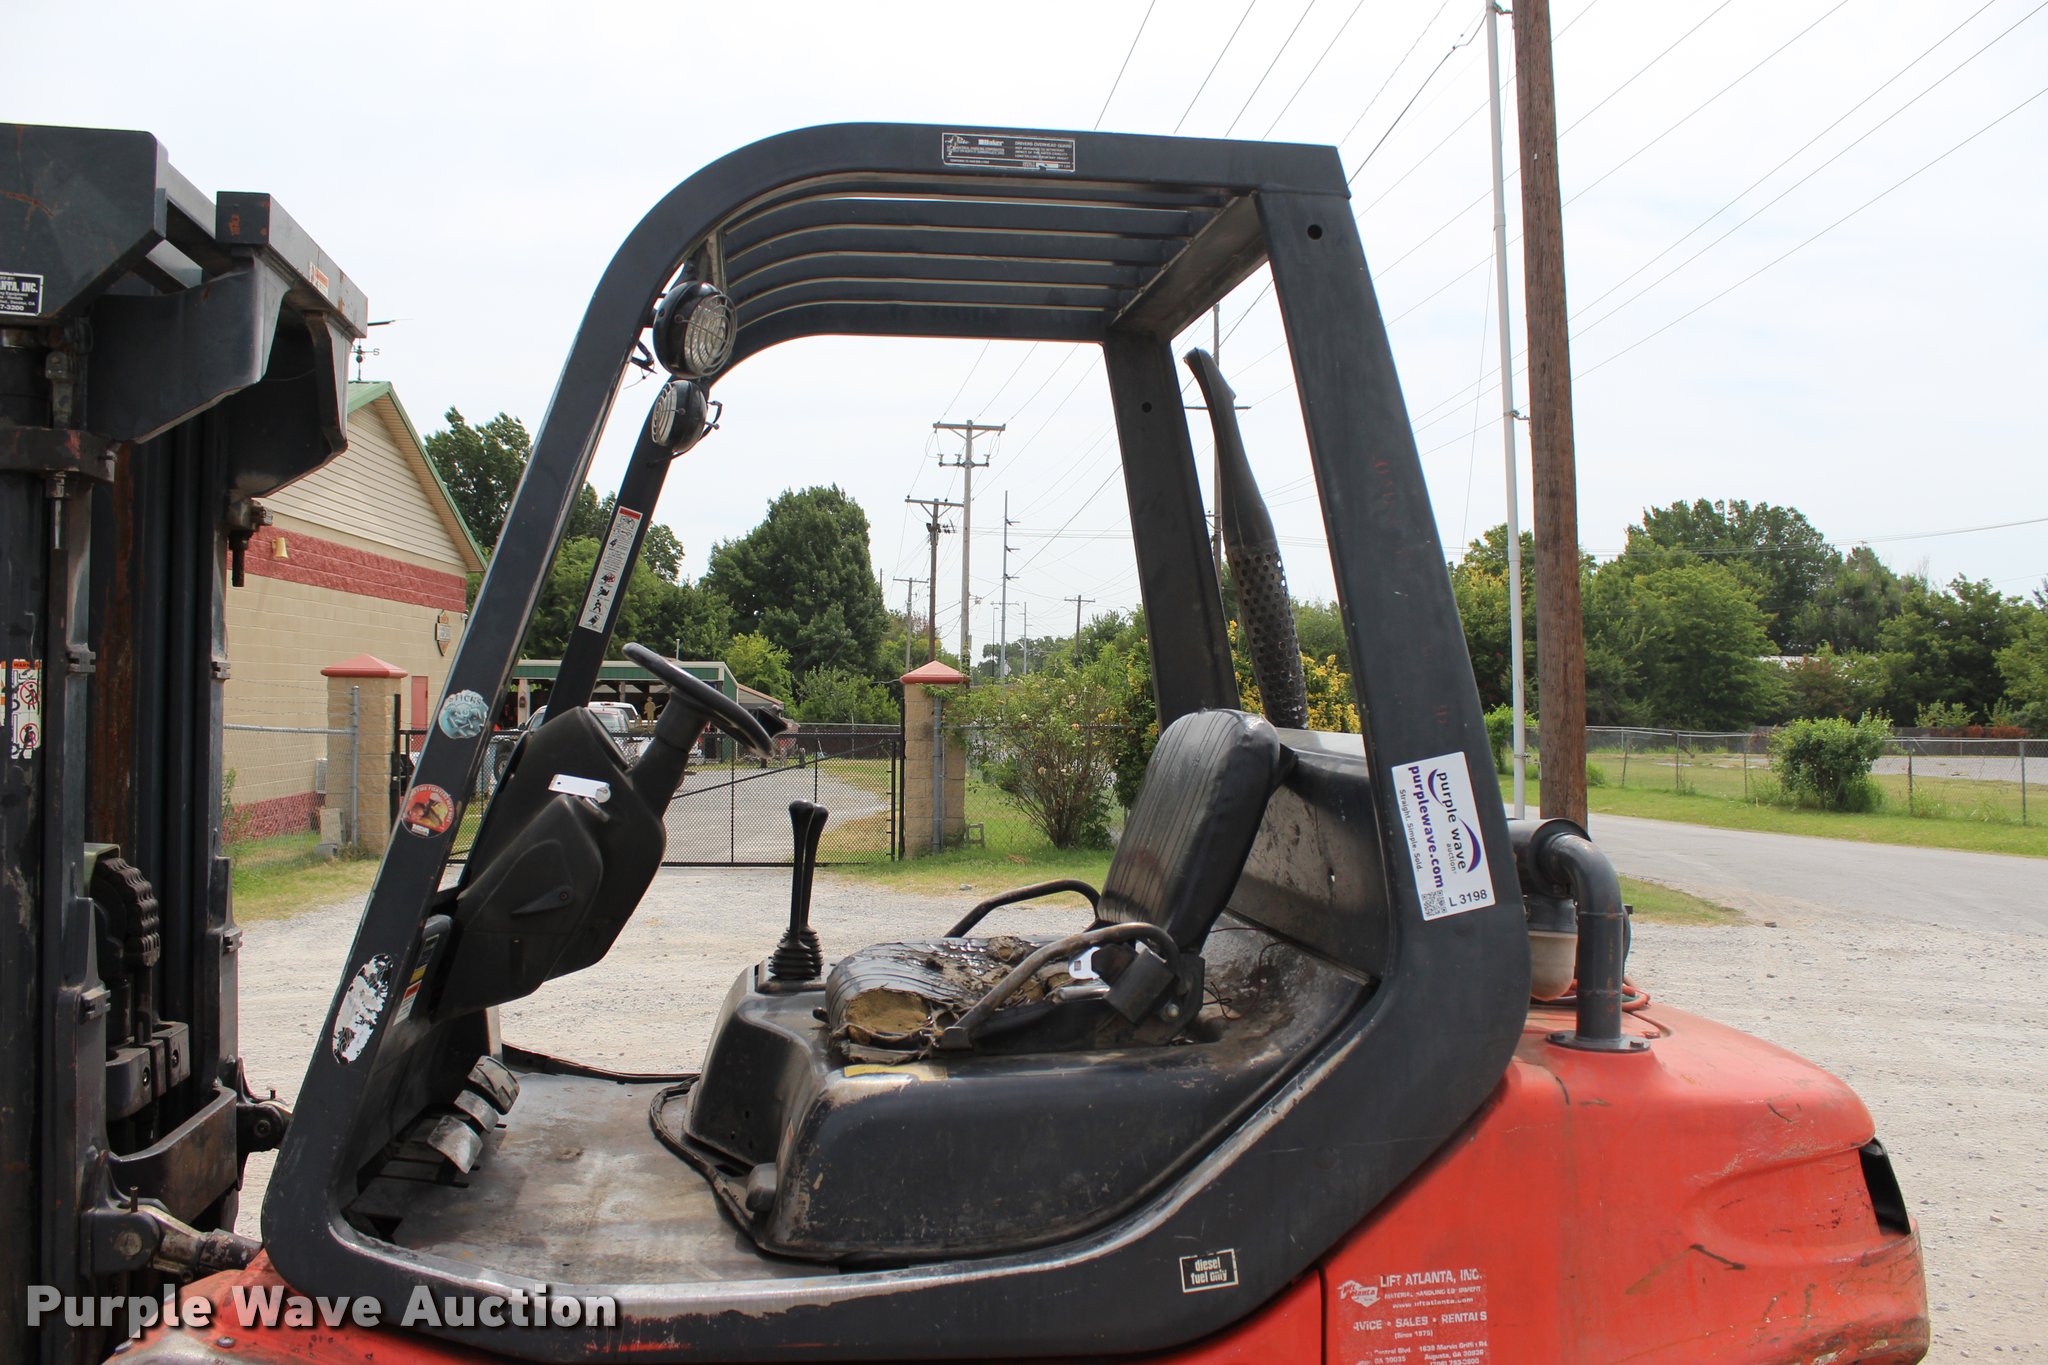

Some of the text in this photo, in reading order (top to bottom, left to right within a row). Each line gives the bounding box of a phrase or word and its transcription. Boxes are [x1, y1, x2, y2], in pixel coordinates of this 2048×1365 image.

[0, 281, 38, 293] NTA, INC.
[1399, 788, 1424, 872] Straight. Simple. Sold.
[1408, 765, 1444, 888] purplewave.com
[1436, 772, 1466, 870] purple wave
[1449, 889, 1488, 907] L 3198
[1195, 1256, 1221, 1272] diesel
[1190, 1269, 1228, 1285] fuel only
[1380, 1268, 1482, 1288] LIFT ATLANTA, INC.
[1395, 1316, 1429, 1328] SALES
